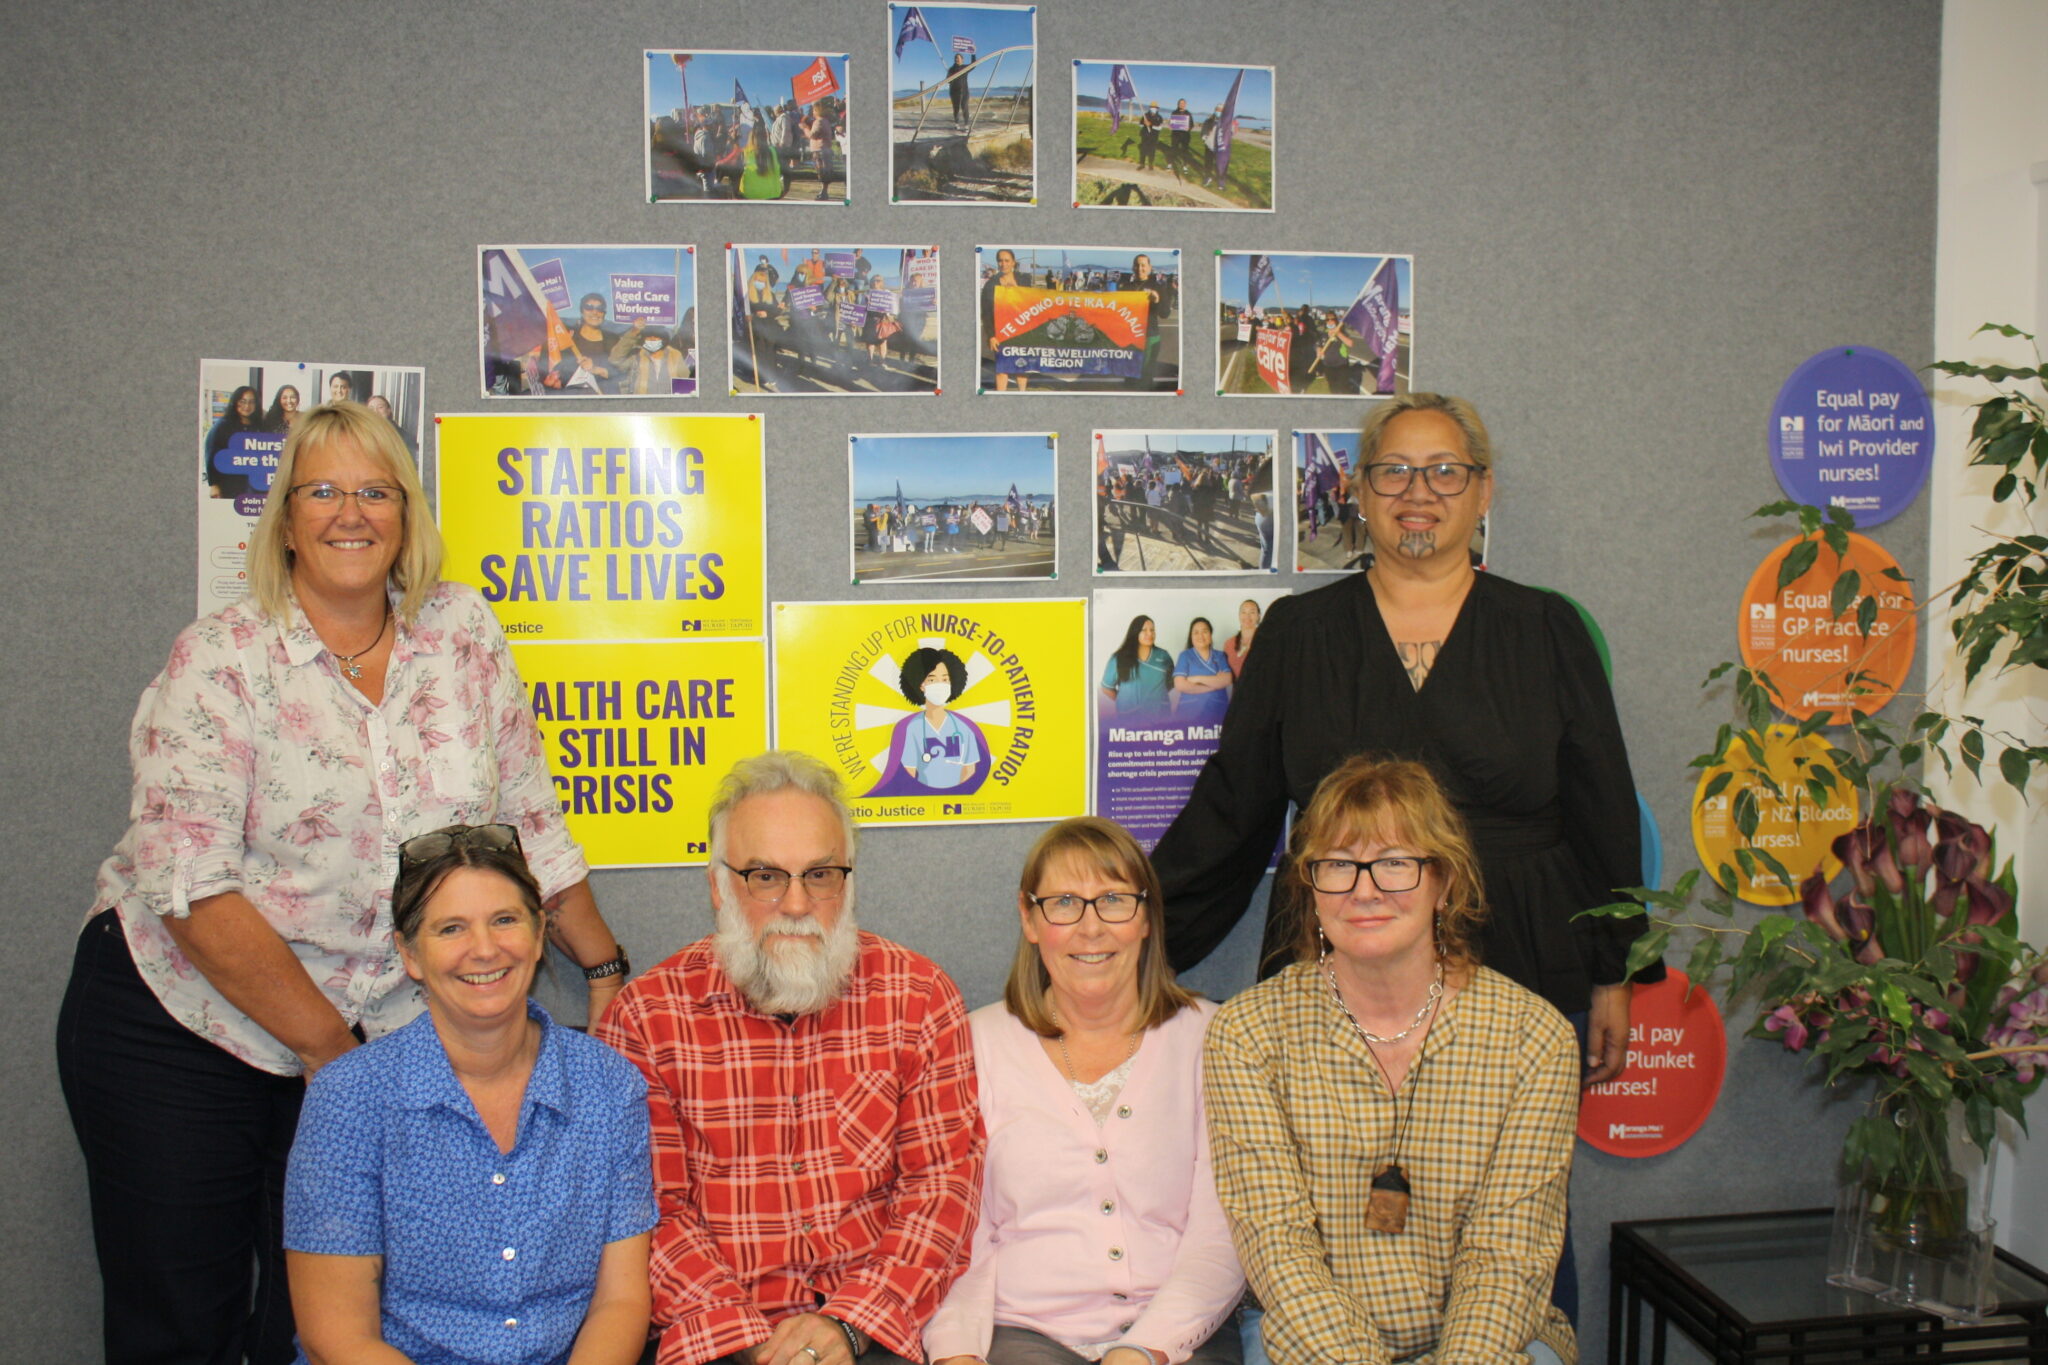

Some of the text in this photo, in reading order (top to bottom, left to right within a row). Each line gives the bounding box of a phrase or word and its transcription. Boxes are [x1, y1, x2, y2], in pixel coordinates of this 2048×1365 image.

[614, 278, 644, 288] Value
[615, 291, 670, 303] Aged Care
[616, 303, 661, 314] Workers
[1000, 322, 1016, 338] TE
[1014, 297, 1053, 326] UPOKO
[1055, 296, 1065, 306] O
[1067, 296, 1081, 307] TE
[1106, 300, 1117, 311] A
[1117, 307, 1145, 338] MAUI
[1002, 346, 1133, 360] GREATER WELLINGTON
[1040, 357, 1084, 368] REGION
[1817, 389, 1900, 411] Equal pay
[1817, 414, 1924, 432] for Māori and
[244, 438, 286, 452] Nursi
[1818, 440, 1844, 457] Iwi
[1849, 439, 1919, 457] Provider
[233, 454, 280, 467] are th
[497, 447, 704, 496] STAFFING
[1819, 464, 1880, 482] nurses!
[243, 506, 257, 514] the
[522, 500, 683, 549] RATIOS
[480, 553, 725, 602] SAVE LIVES
[1783, 590, 1831, 613] Equal
[1879, 591, 1904, 609] for
[501, 621, 544, 634] ustice
[1783, 617, 1808, 636] GP
[1815, 617, 1889, 636] Practce
[1783, 644, 1848, 663] nurses!
[532, 679, 735, 721] ALTH CARE
[830, 650, 869, 728] STANDING
[862, 631, 884, 657] UP
[884, 615, 918, 643] FOR
[921, 613, 1035, 722] NURSE-TO-PATIENT
[992, 726, 1035, 787] RATIOS
[1109, 724, 1222, 746] Maranga Mai!
[559, 726, 706, 768] STILL IN
[1108, 750, 1122, 758] Rise
[1124, 751, 1133, 759] up
[1143, 749, 1155, 757] win
[1156, 749, 1167, 757] the
[1169, 748, 1195, 758] political
[1108, 760, 1155, 768] commitments
[1156, 759, 1180, 767] needed
[1190, 758, 1207, 766] addr
[1108, 769, 1201, 779] shortage crisis permanently
[552, 773, 674, 815] CRISIS
[848, 804, 925, 817] atio Justice
[1772, 805, 1794, 823] NZ
[1799, 804, 1852, 822] Bloods
[1651, 1027, 1684, 1046] pay
[1626, 1050, 1695, 1069] Plunket
[1590, 1077, 1657, 1095] nurses!
